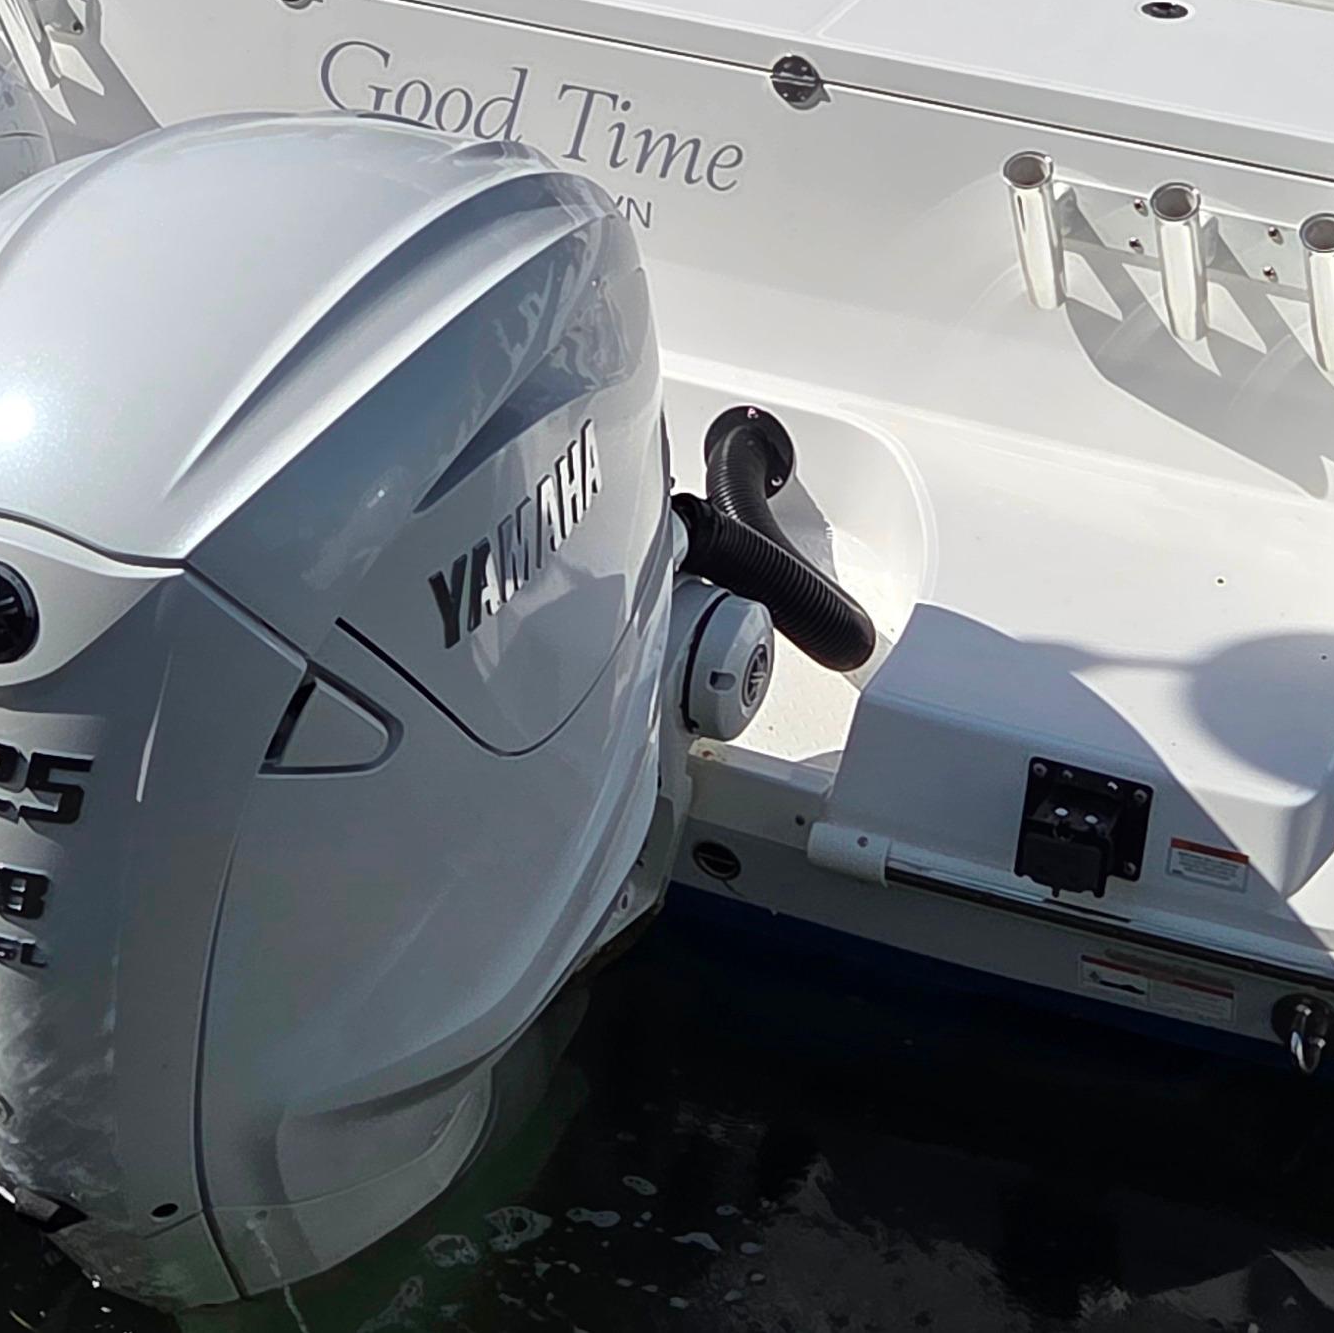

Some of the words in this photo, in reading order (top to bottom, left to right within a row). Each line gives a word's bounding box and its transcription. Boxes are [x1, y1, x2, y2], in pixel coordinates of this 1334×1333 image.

[320, 40, 528, 142] Good
[556, 82, 744, 192] Time
[427, 418, 603, 650] YAMAHA
